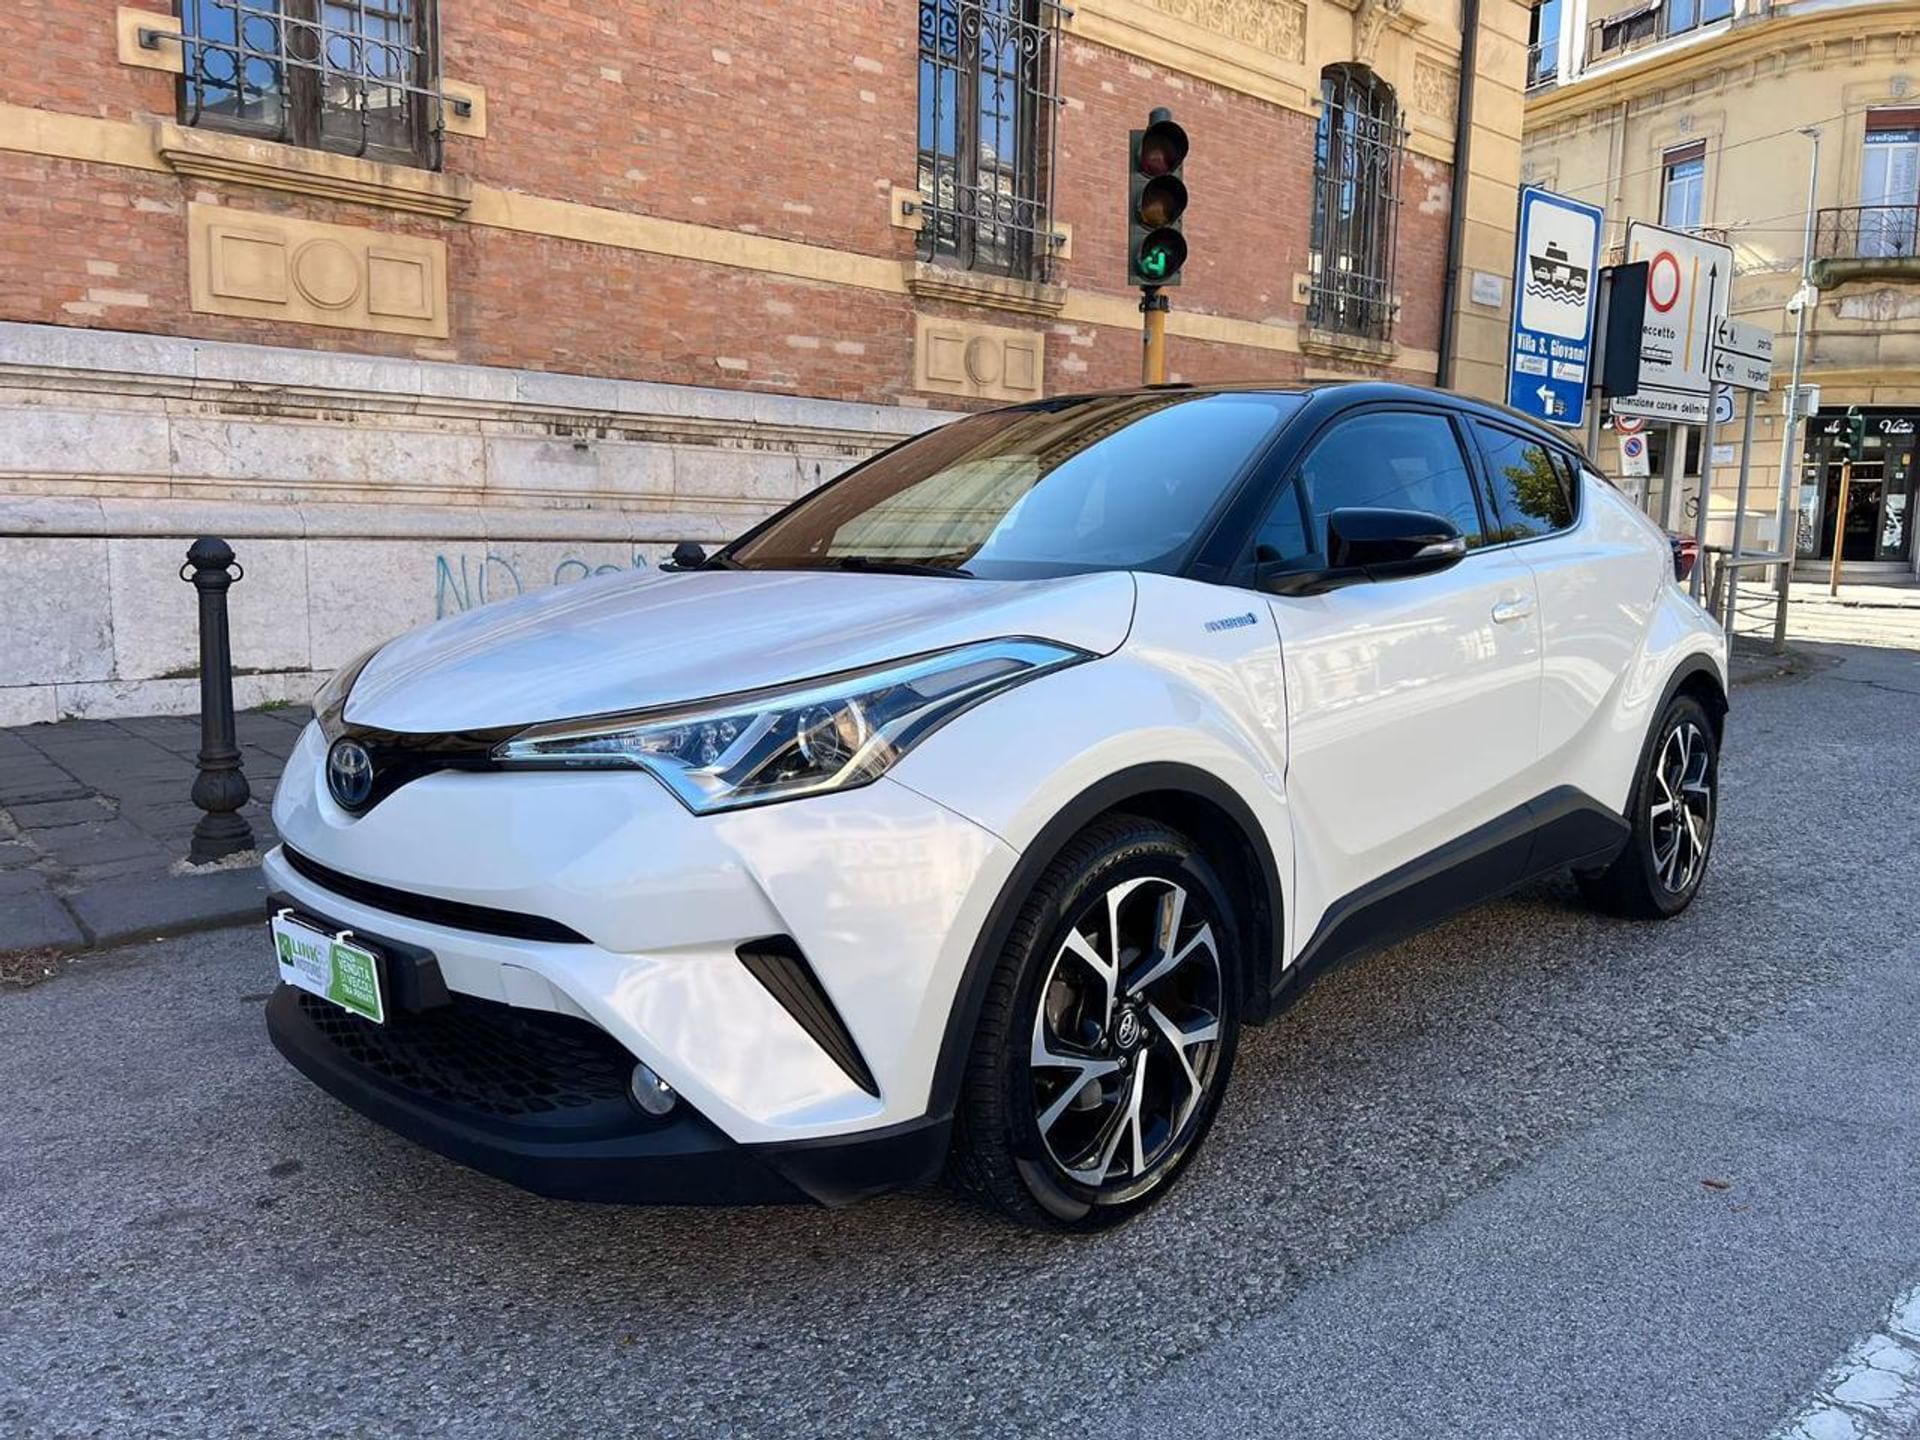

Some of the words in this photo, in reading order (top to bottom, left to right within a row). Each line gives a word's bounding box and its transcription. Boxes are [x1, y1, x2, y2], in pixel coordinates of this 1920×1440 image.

[1642, 326, 1676, 340] eccetto
[1517, 332, 1536, 353] Villa
[1539, 338, 1548, 355] S.
[1551, 339, 1587, 362] Giovanni
[1656, 400, 1678, 412] corsie
